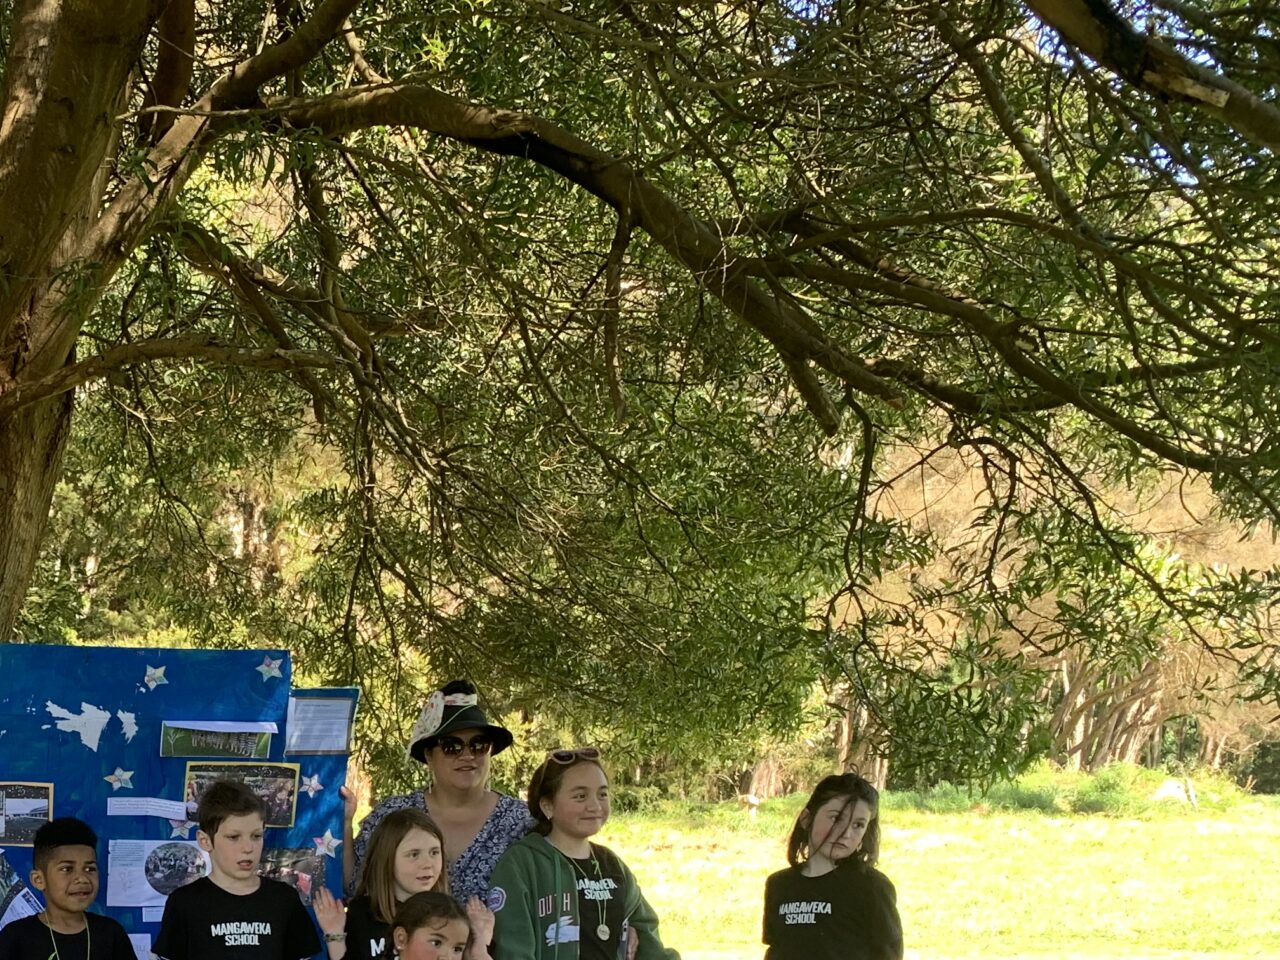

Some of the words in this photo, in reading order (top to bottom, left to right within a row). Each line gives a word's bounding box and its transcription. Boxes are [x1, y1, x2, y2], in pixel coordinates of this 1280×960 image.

[779, 901, 832, 915] MANGAWEKA
[785, 913, 816, 925] SCHOOL
[211, 922, 272, 937] MANGAWEKA
[225, 934, 261, 946] SCHOOL
